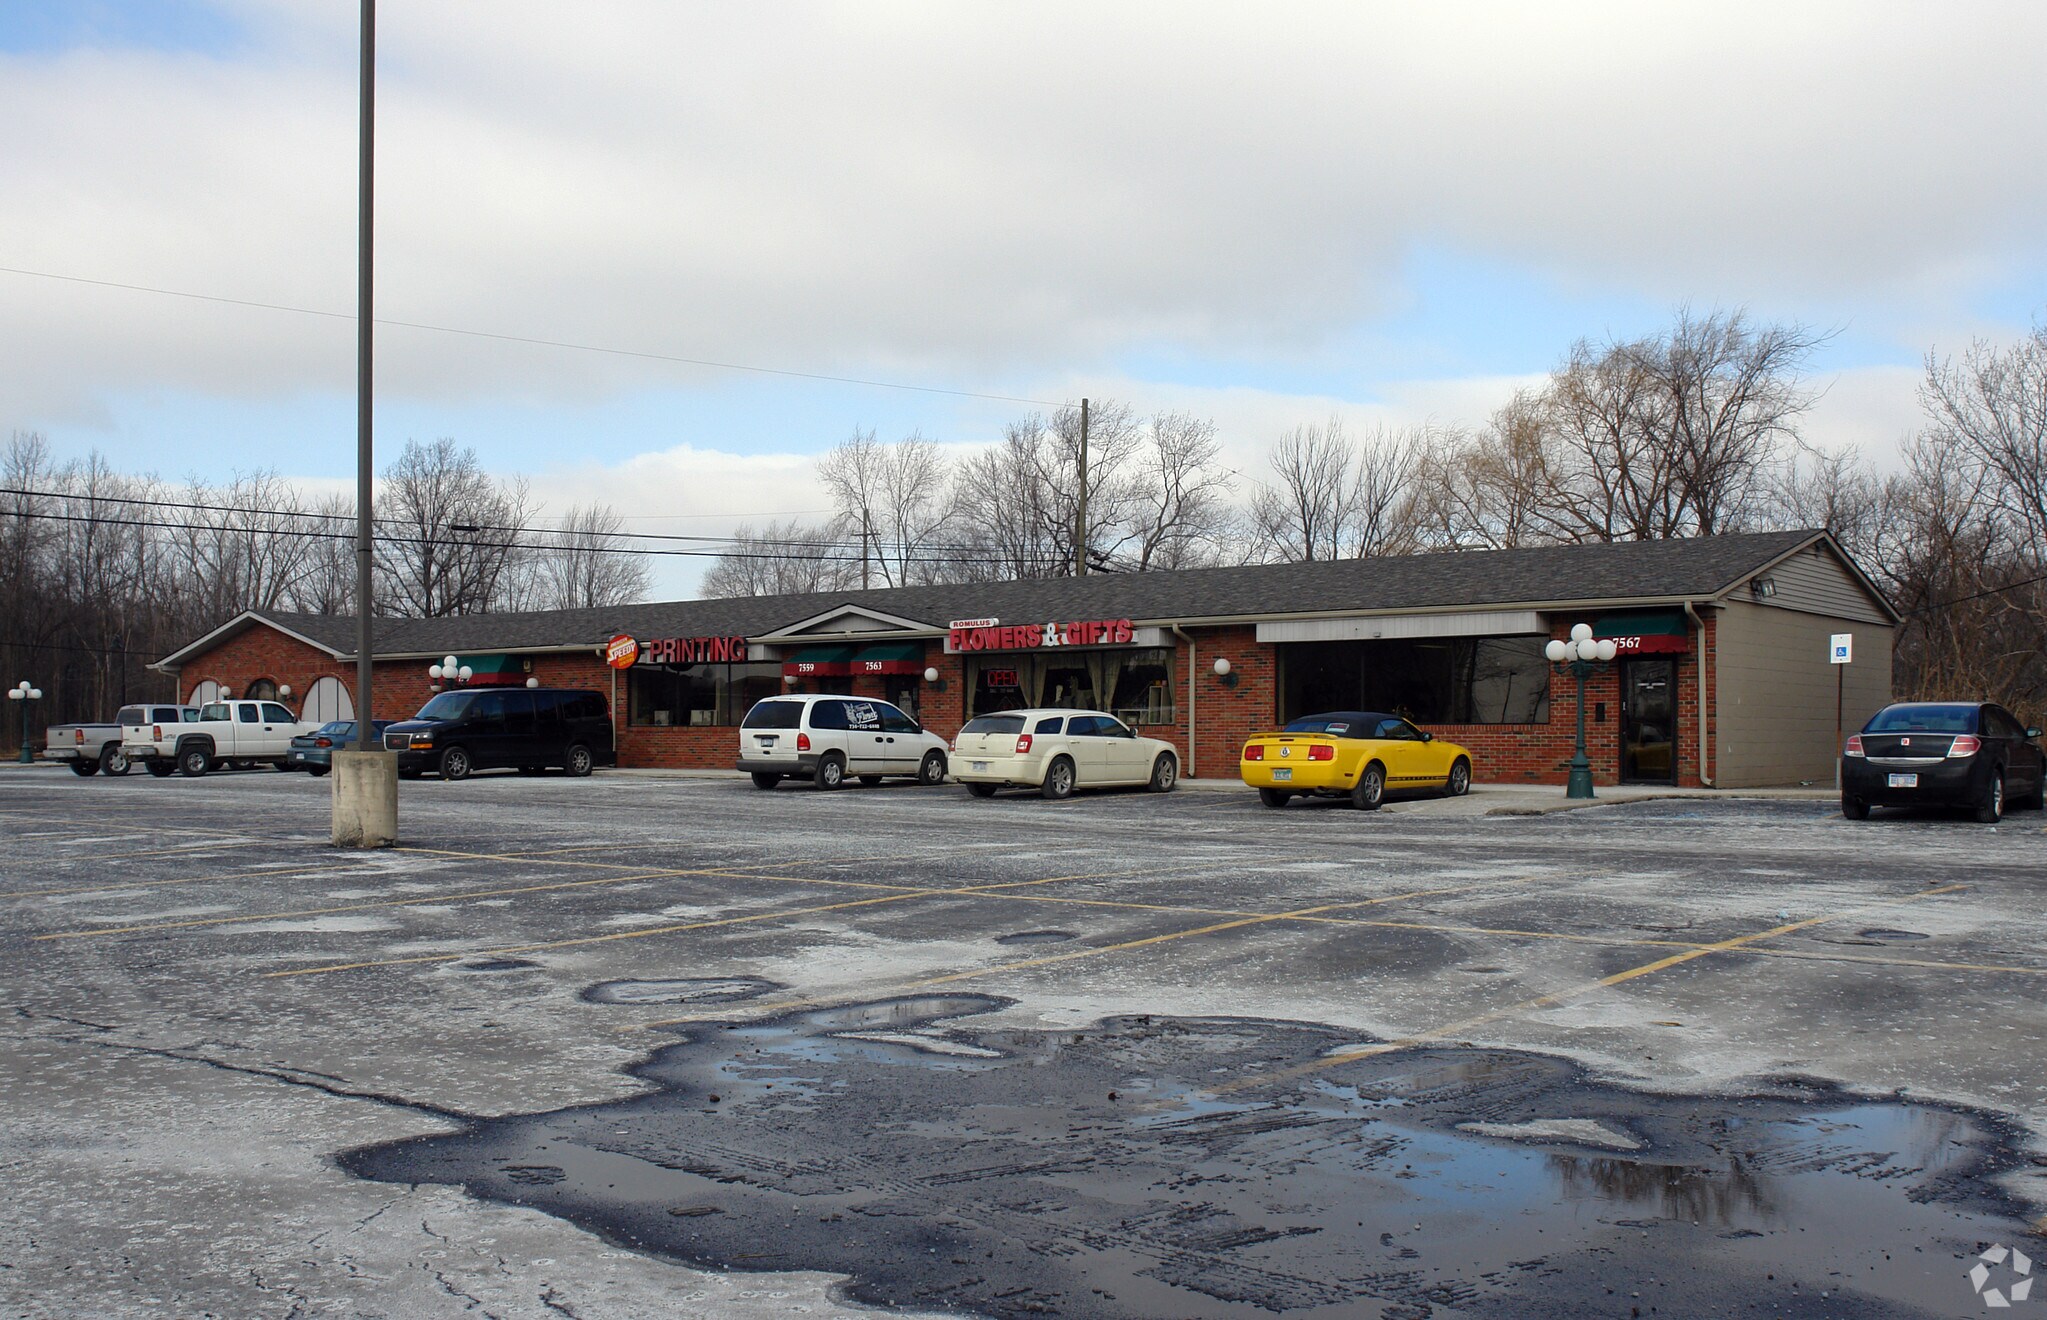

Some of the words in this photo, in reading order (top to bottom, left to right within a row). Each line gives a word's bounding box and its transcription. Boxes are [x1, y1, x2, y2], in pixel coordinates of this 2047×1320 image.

[953, 619, 991, 628] ROMULUS
[949, 624, 1042, 650] FLOWERS
[1046, 622, 1059, 647] &
[1066, 618, 1134, 646] GIFTS
[1612, 637, 1641, 648] 7567
[608, 640, 635, 661] SPEEDY
[650, 637, 746, 663] PRINTING
[799, 663, 815, 672] 7559
[865, 662, 882, 670] 7563
[988, 671, 1018, 686] OPEN
